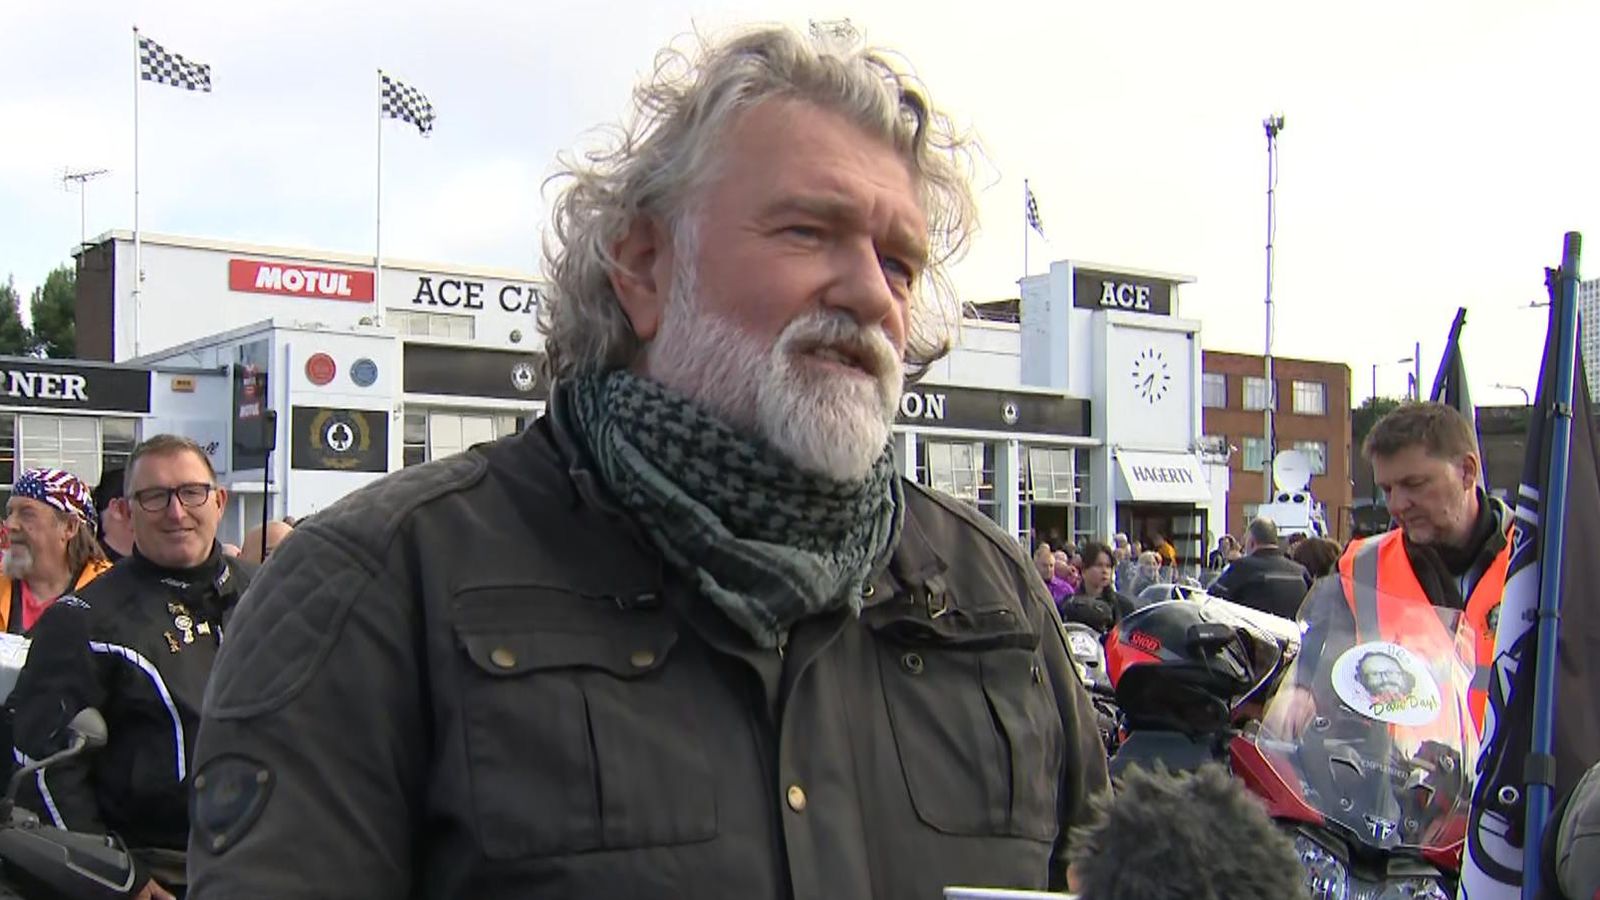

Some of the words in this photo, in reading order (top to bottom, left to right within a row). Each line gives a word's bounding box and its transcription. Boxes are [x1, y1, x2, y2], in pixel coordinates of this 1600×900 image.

[255, 265, 352, 296] MOTUL
[412, 277, 484, 309] ACE
[1100, 280, 1150, 310] ACE
[0, 370, 88, 401] NER
[901, 392, 946, 420] ON
[1132, 466, 1194, 484] HAGERTY
